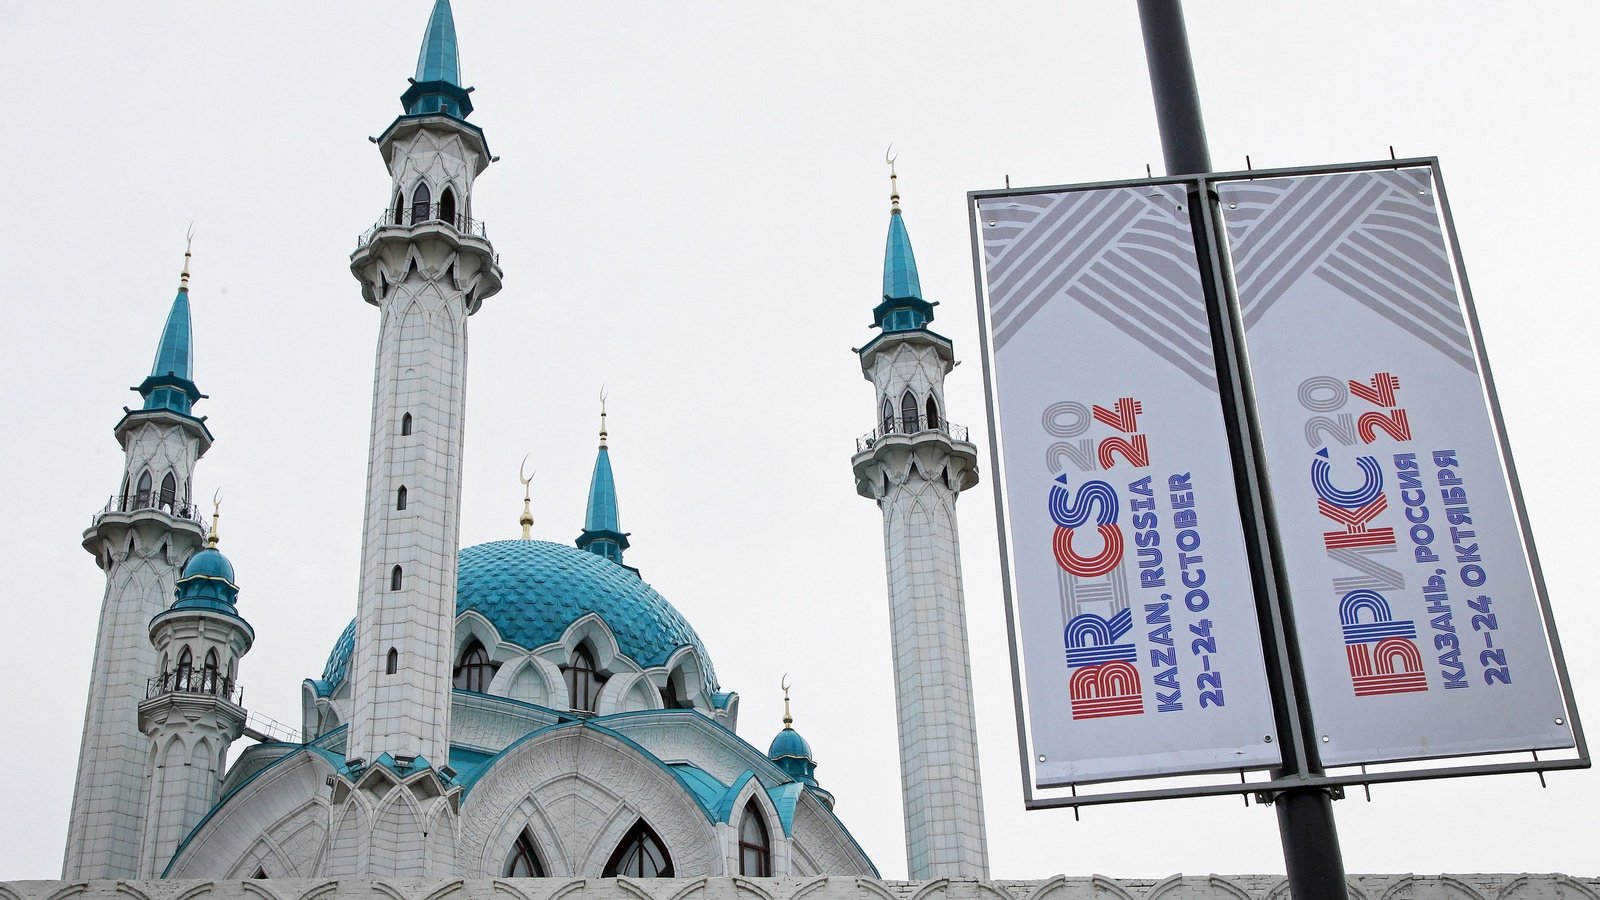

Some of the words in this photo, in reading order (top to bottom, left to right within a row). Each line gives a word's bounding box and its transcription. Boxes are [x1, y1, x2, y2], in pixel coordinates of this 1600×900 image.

[1041, 400, 1097, 475] 20
[1092, 397, 1150, 471] 24
[1297, 375, 1358, 449] 20
[1347, 372, 1412, 445] 24
[1128, 475, 1166, 589] RUSSIA
[1167, 471, 1210, 613] OCTOBER
[1393, 452, 1440, 564] РОССИЯ
[1432, 449, 1487, 588] ОКТЯБРЯ
[1048, 479, 1144, 721] BRICS
[1310, 455, 1429, 697] БРИКС
[1421, 568, 1469, 690] КАЗАНЬ,
[1143, 593, 1183, 713] KAZAN,
